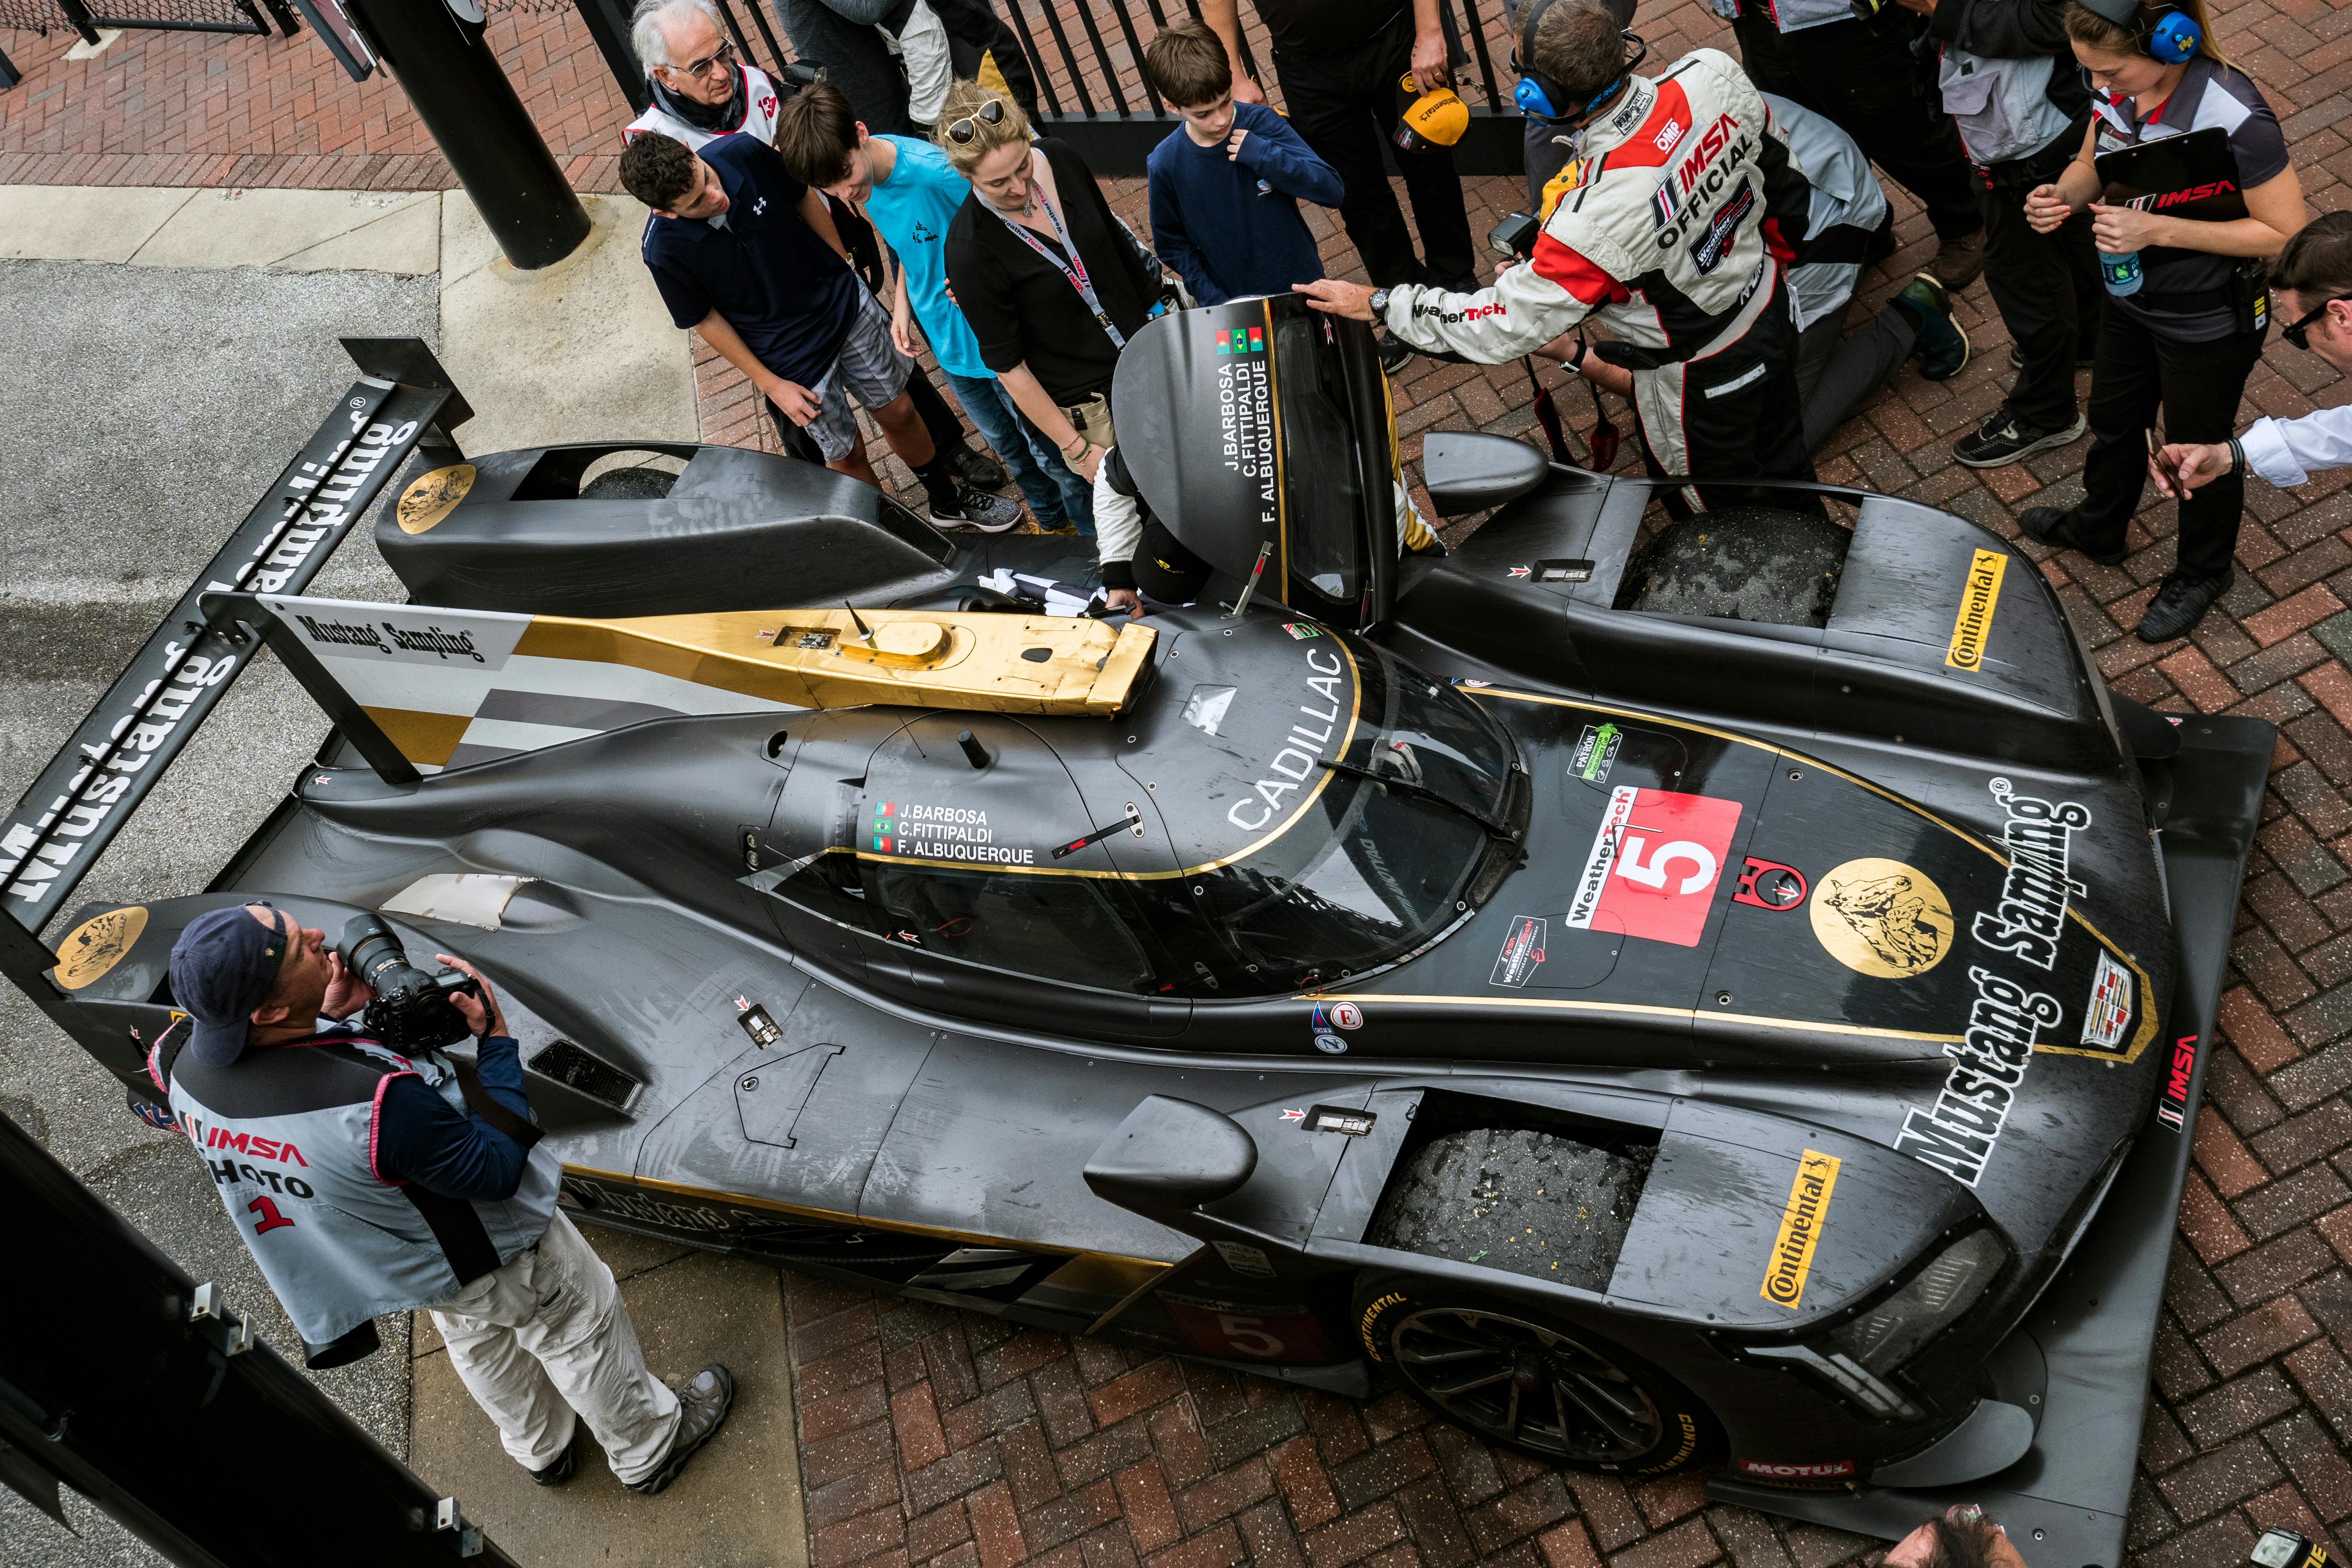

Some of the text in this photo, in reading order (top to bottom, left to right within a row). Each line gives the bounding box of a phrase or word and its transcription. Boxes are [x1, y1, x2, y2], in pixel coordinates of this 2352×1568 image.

[1656, 121, 1680, 151] OMP
[1679, 112, 1739, 196] IMSA
[1034, 185, 1063, 234] WeatherTech
[1657, 133, 1753, 250] OFFICIAL
[2156, 180, 2236, 209] IMSA
[1001, 217, 1044, 252] WeatherTech
[1069, 274, 1084, 294] IMSA
[1073, 254, 1086, 278] IMSA
[1218, 363, 1239, 471] J.BARBOSA
[1235, 363, 1257, 477] C.FITTIPALDI
[1252, 360, 1275, 522] F. ALBUQUERQUE
[295, 615, 392, 654] Mustang
[1952, 568, 1995, 668] Continental
[1228, 648, 1342, 831] CADILLAC
[1576, 735, 1597, 768] PATRÓN
[1590, 747, 1605, 774] ENDURANCE
[0, 641, 236, 902] Mustang
[899, 822, 992, 843] C.FITTIPALDI
[900, 804, 987, 825] J.BARBOSA
[897, 839, 1034, 864] F. ALBUQUERQUE
[1615, 836, 1717, 894] 5
[1504, 920, 1534, 983] WeatherTech
[1338, 1010, 1356, 1025] E
[1320, 1039, 1340, 1049] N
[1893, 965, 2063, 1188] Mustang
[2167, 1035, 2198, 1102] IMSA
[207, 1127, 309, 1168] IMSA
[247, 1195, 296, 1236] 1
[1218, 1243, 1259, 1255] ROLEX
[1767, 1173, 1826, 1303] Continental
[1218, 1313, 1285, 1357] 5
[1362, 1292, 1407, 1362] CONTINENTAL
[1637, 1413, 1696, 1474] CONTINENTAL
[1748, 1463, 1848, 1475] MOTUL
